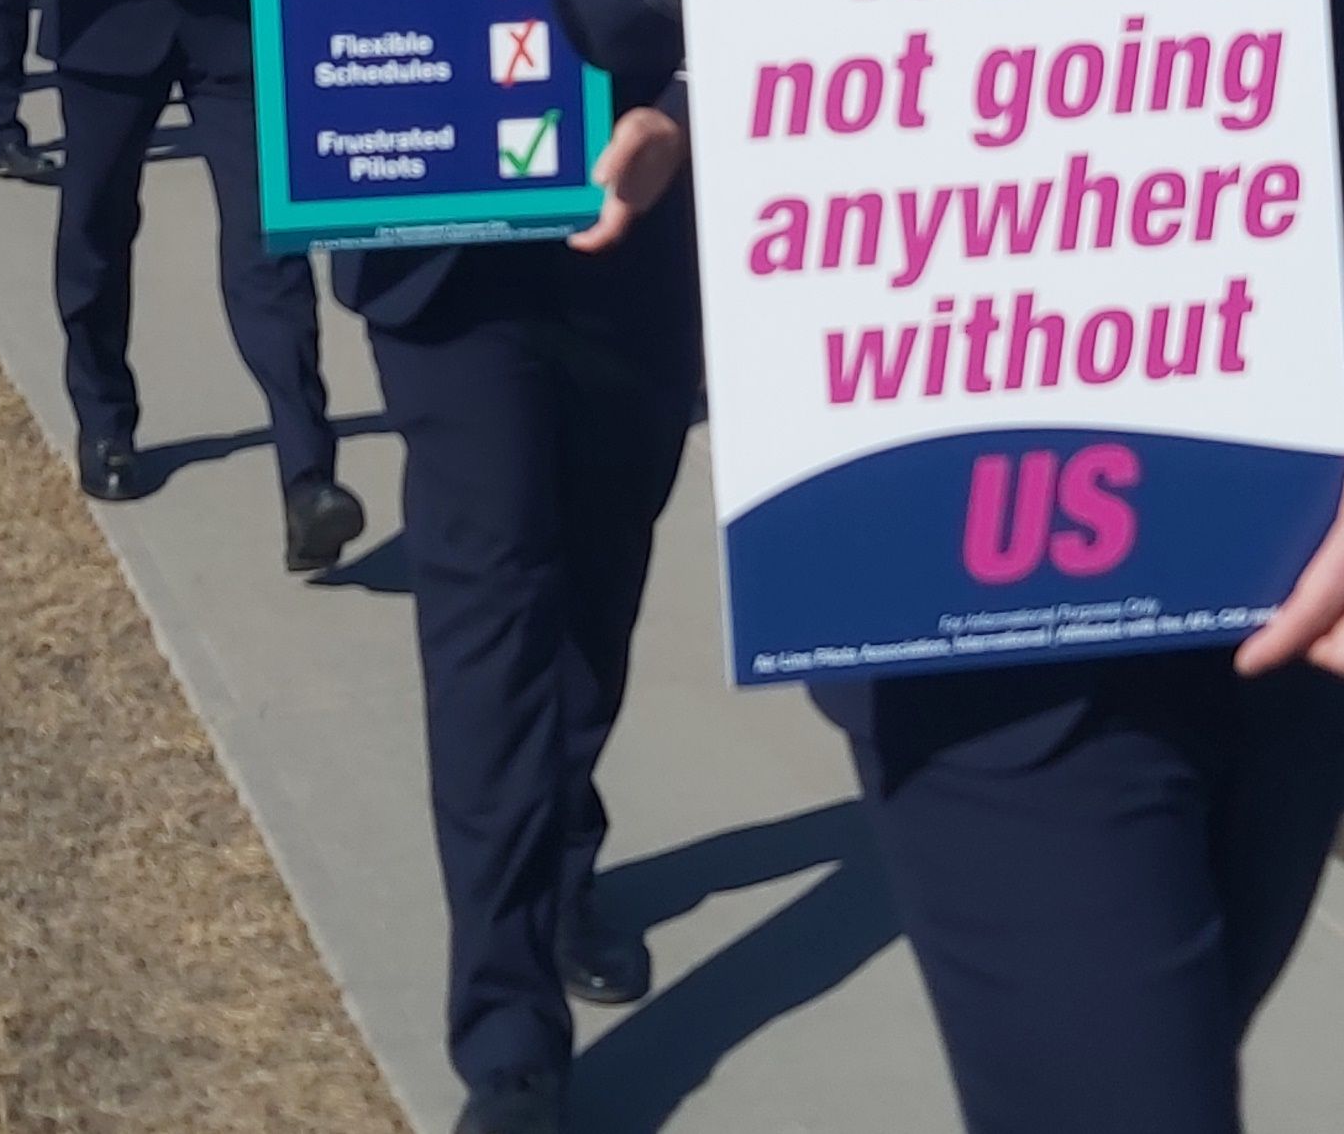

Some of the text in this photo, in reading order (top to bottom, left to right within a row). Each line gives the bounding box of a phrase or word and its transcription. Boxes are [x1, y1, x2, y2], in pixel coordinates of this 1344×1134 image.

[314, 58, 453, 88] Schedules
[330, 30, 434, 60] Flexible
[749, 16, 1284, 148] not going
[317, 124, 455, 157] Frustrated
[349, 155, 426, 182] Pilots
[748, 154, 1301, 288] anywhere
[824, 276, 1254, 404] without
[962, 443, 1143, 585] US
